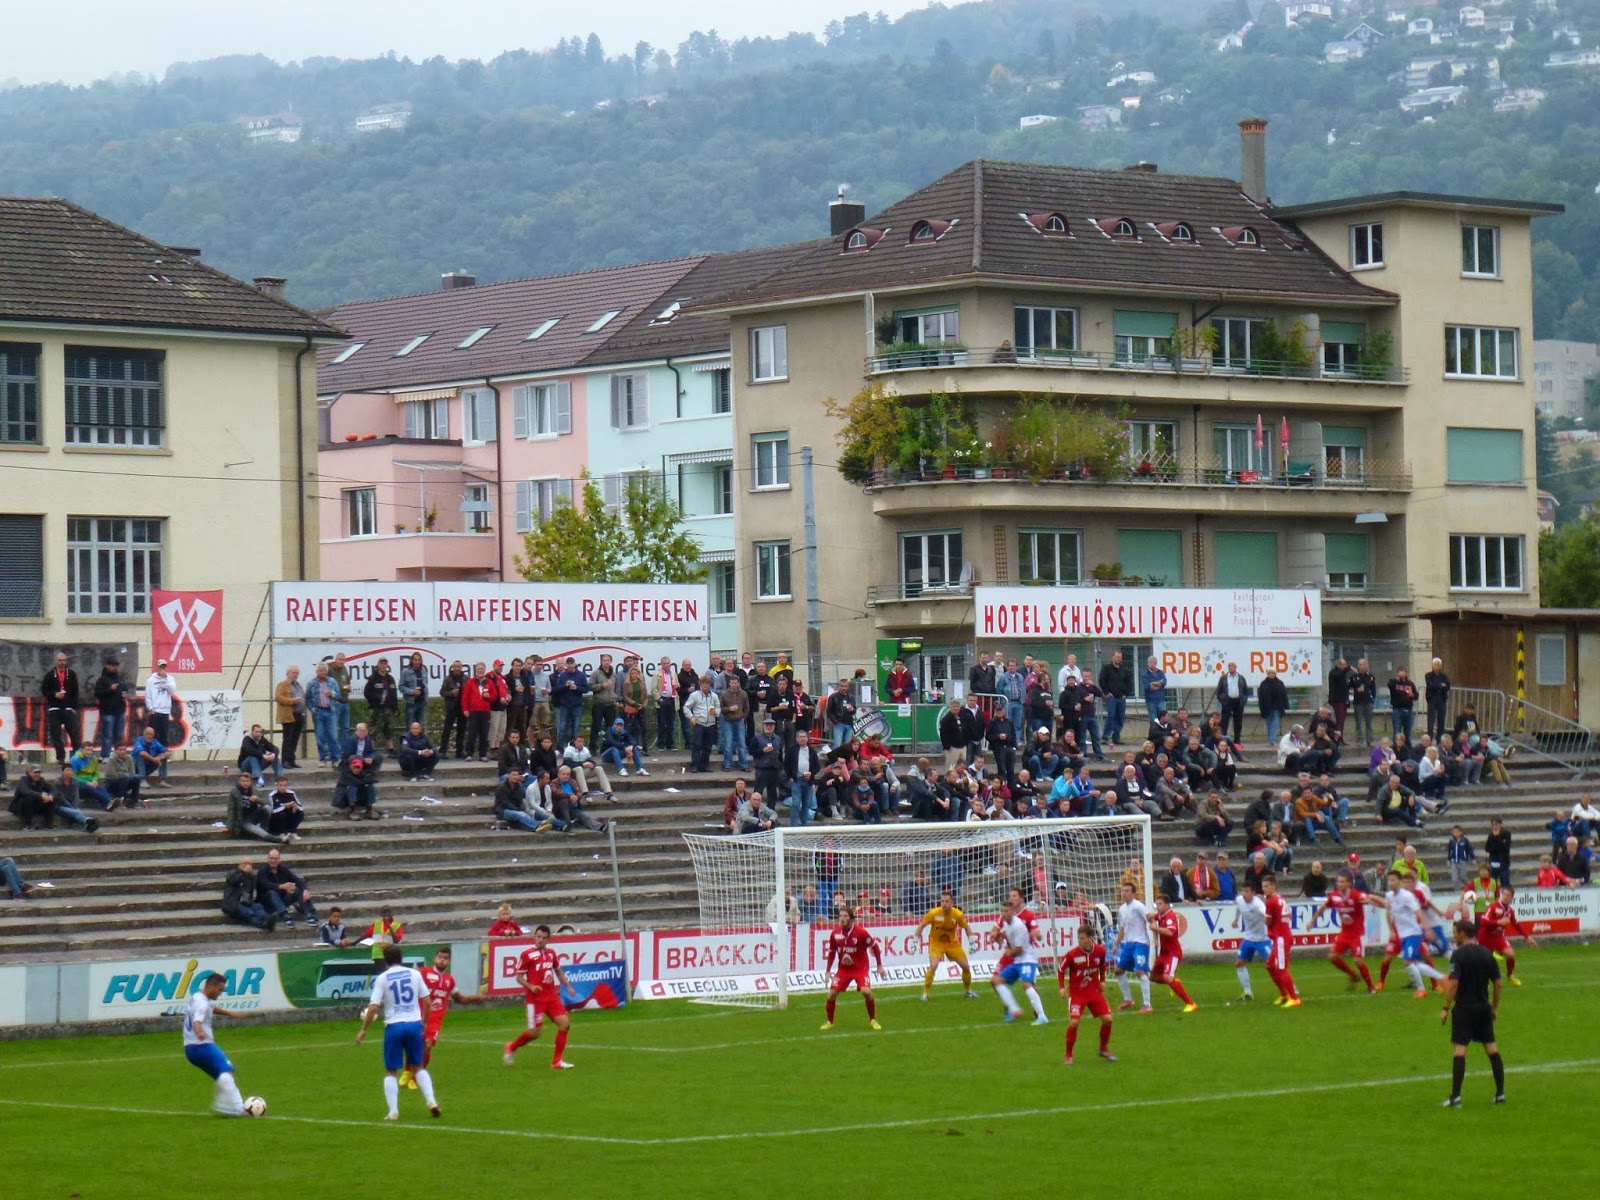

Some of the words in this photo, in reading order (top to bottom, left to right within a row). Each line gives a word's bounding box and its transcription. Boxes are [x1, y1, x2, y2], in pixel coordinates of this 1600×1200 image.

[286, 597, 416, 622] RAIFFEISEN
[438, 598, 561, 622] RAIFFEISEN
[582, 599, 698, 622] RAIFFEISEN
[984, 604, 1041, 634] HOTEL
[1049, 598, 1143, 634] SCHLÖSSLI
[1151, 606, 1213, 634] IPSACH
[178, 658, 195, 671] 1896
[1162, 651, 1201, 674] RJB
[1250, 651, 1289, 674] RJB
[1519, 894, 1534, 905] alle
[1536, 892, 1553, 904] Ihre
[1554, 891, 1581, 903] Reisen
[1517, 907, 1535, 916] tous
[1537, 907, 1551, 915] vos
[1553, 904, 1588, 917] voyages
[1200, 908, 1225, 935] V.
[564, 968, 609, 983] Swisscom
[610, 965, 623, 979] TV
[389, 978, 415, 1005] 15
[668, 979, 739, 995] TELECLUB
